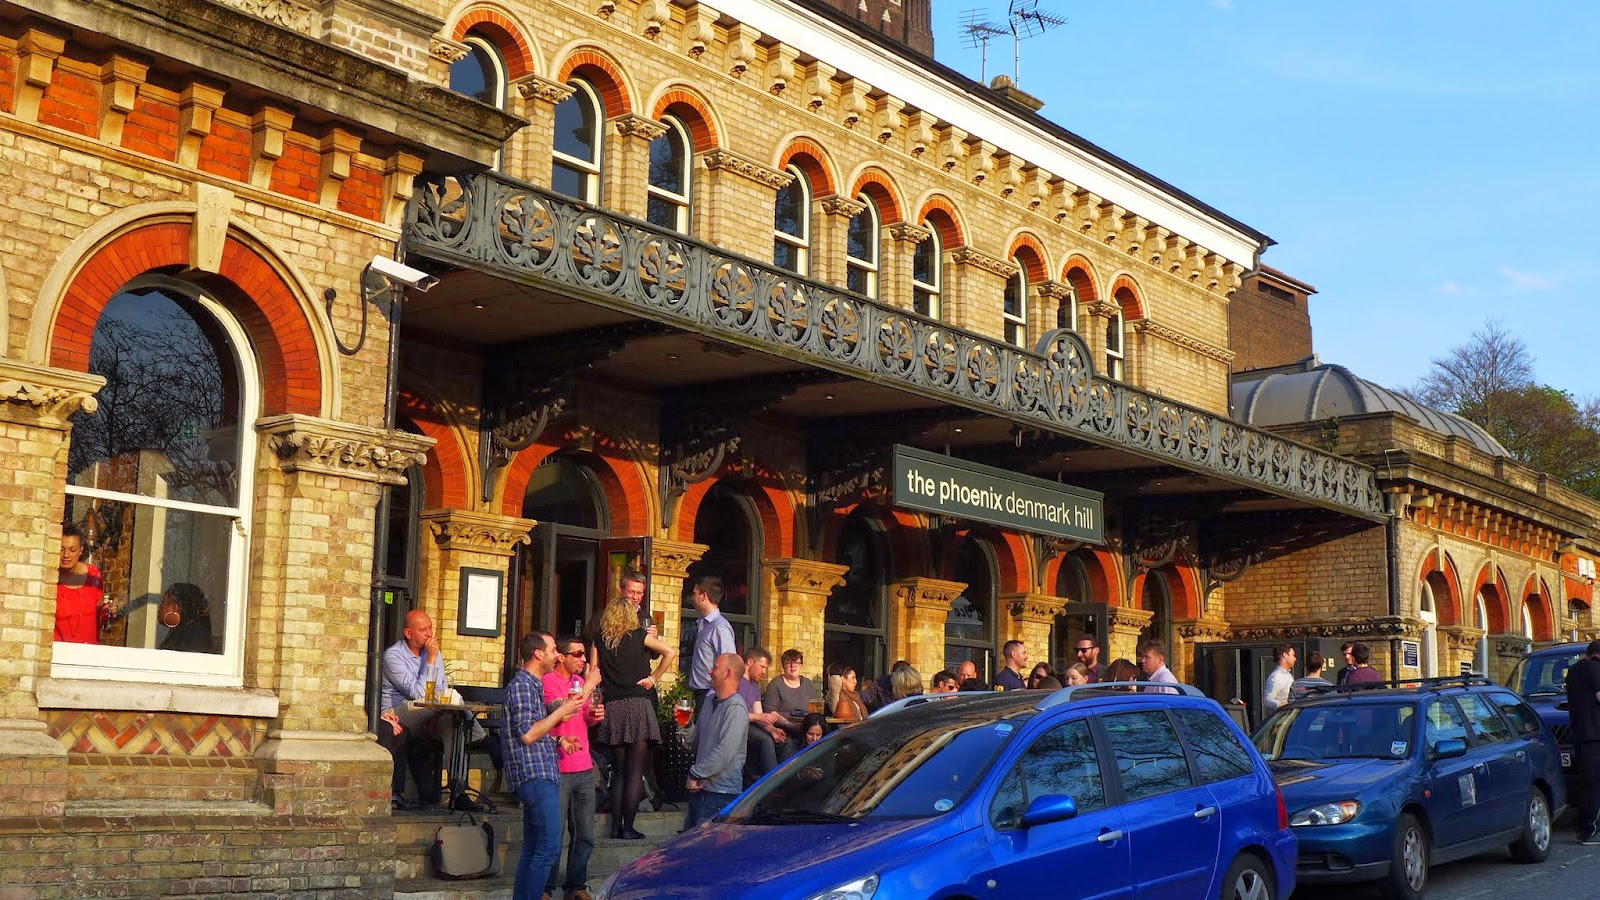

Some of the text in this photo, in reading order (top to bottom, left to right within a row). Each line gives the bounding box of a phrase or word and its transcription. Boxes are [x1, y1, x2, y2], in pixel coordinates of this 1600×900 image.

[907, 469, 1094, 530] the phoenix denmark hill
